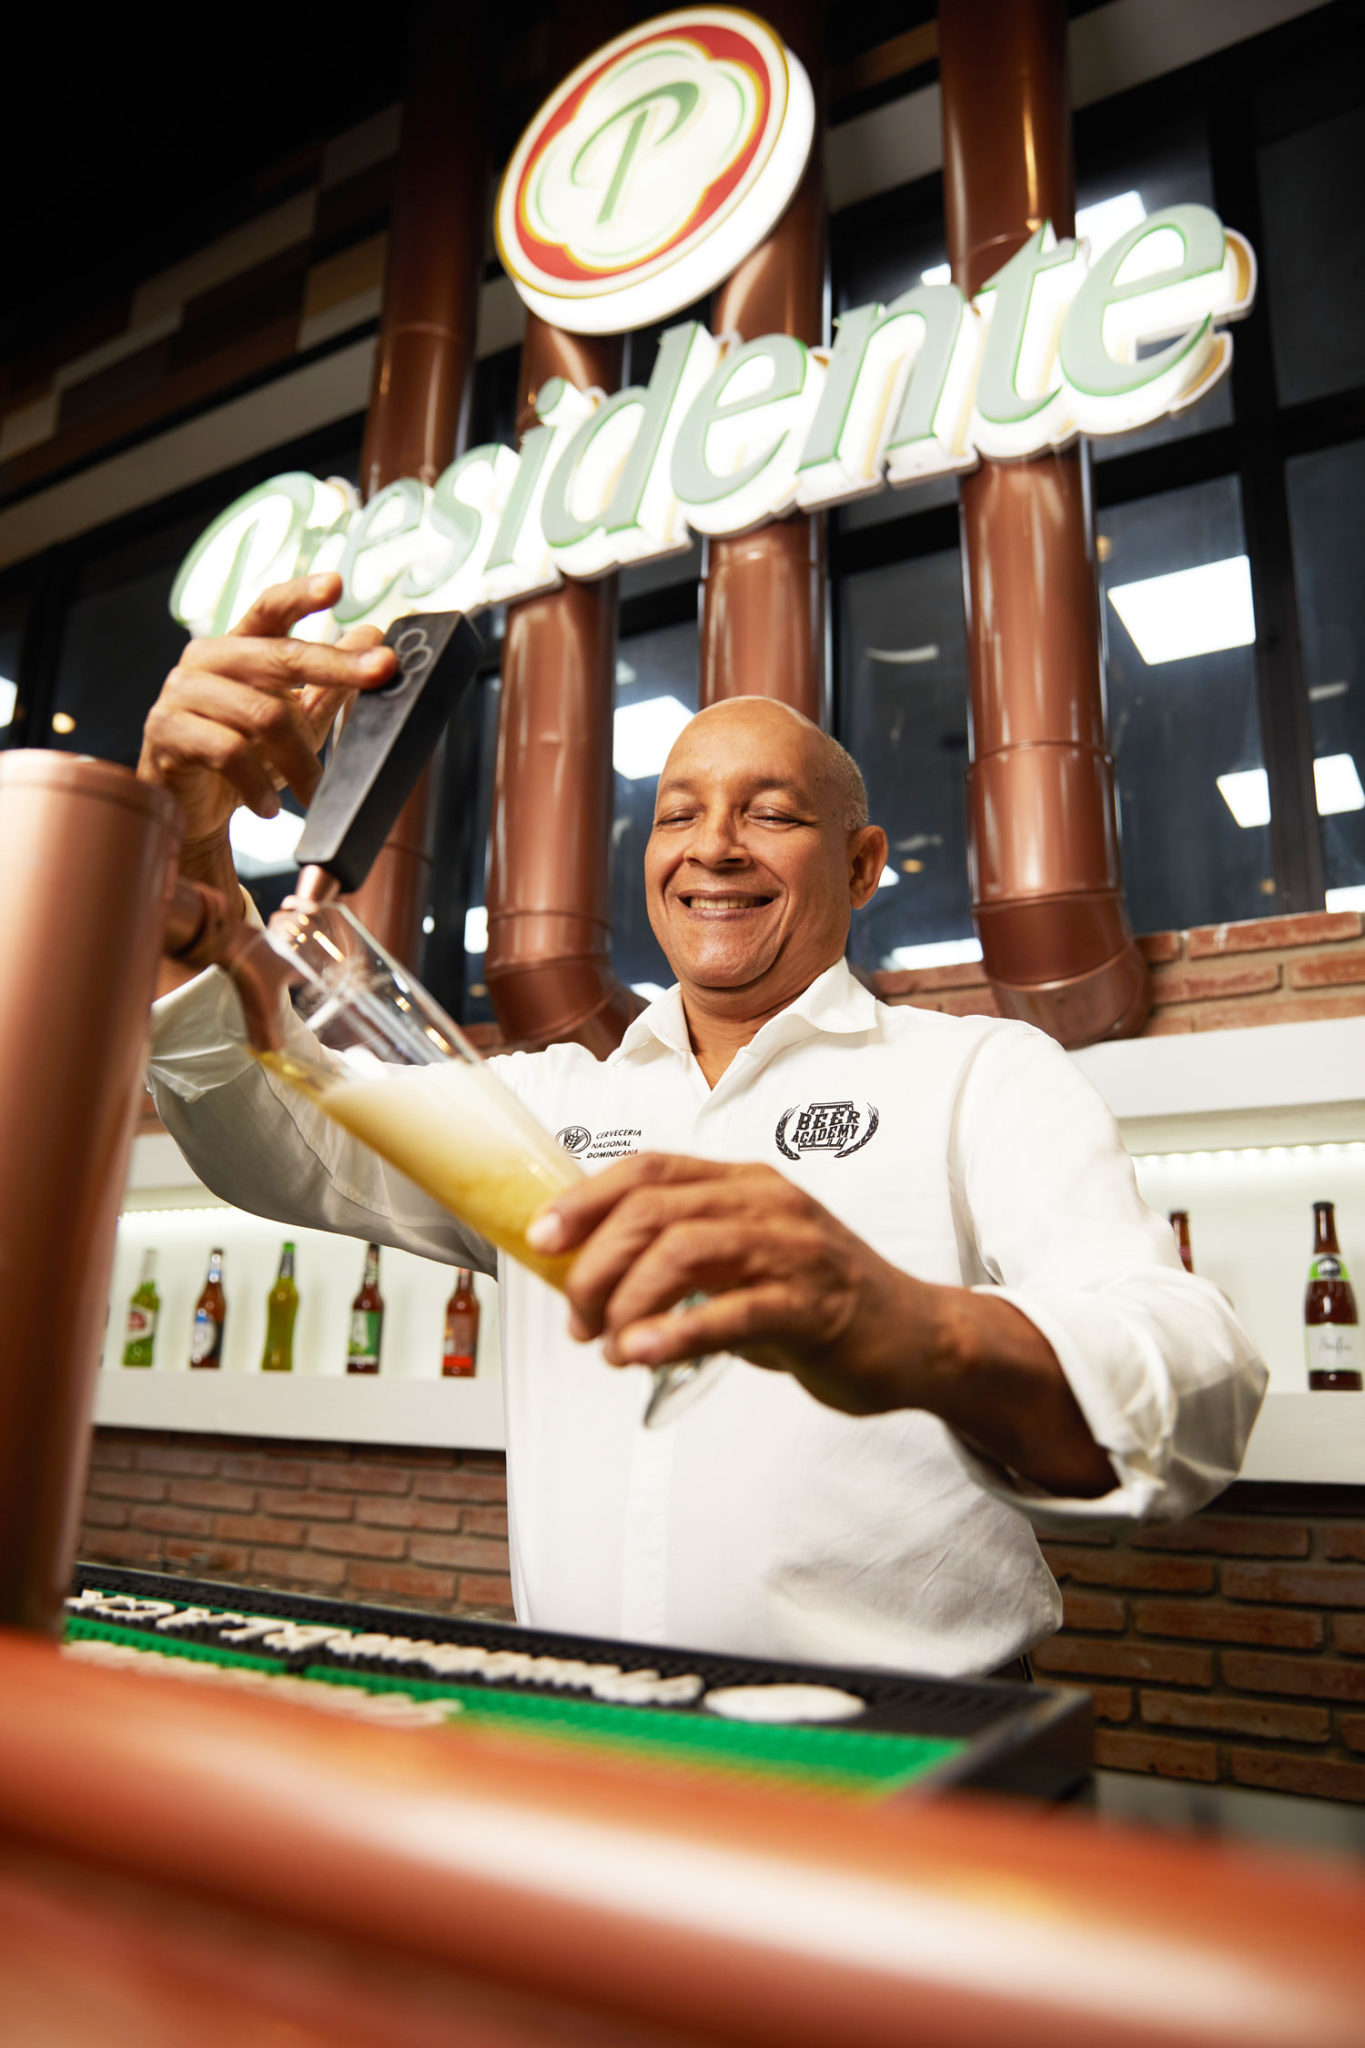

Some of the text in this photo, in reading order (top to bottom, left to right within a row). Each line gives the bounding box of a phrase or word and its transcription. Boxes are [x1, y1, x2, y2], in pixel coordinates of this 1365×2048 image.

[570, 81, 700, 225] P
[168, 203, 1240, 638] Presidente
[796, 1110, 861, 1131] BEER
[596, 1129, 642, 1139] CERVECERIA
[791, 1124, 860, 1143] ACADEMY
[586, 1149, 639, 1159] DOMINICANA
[591, 1140, 632, 1149] NACIONAL
